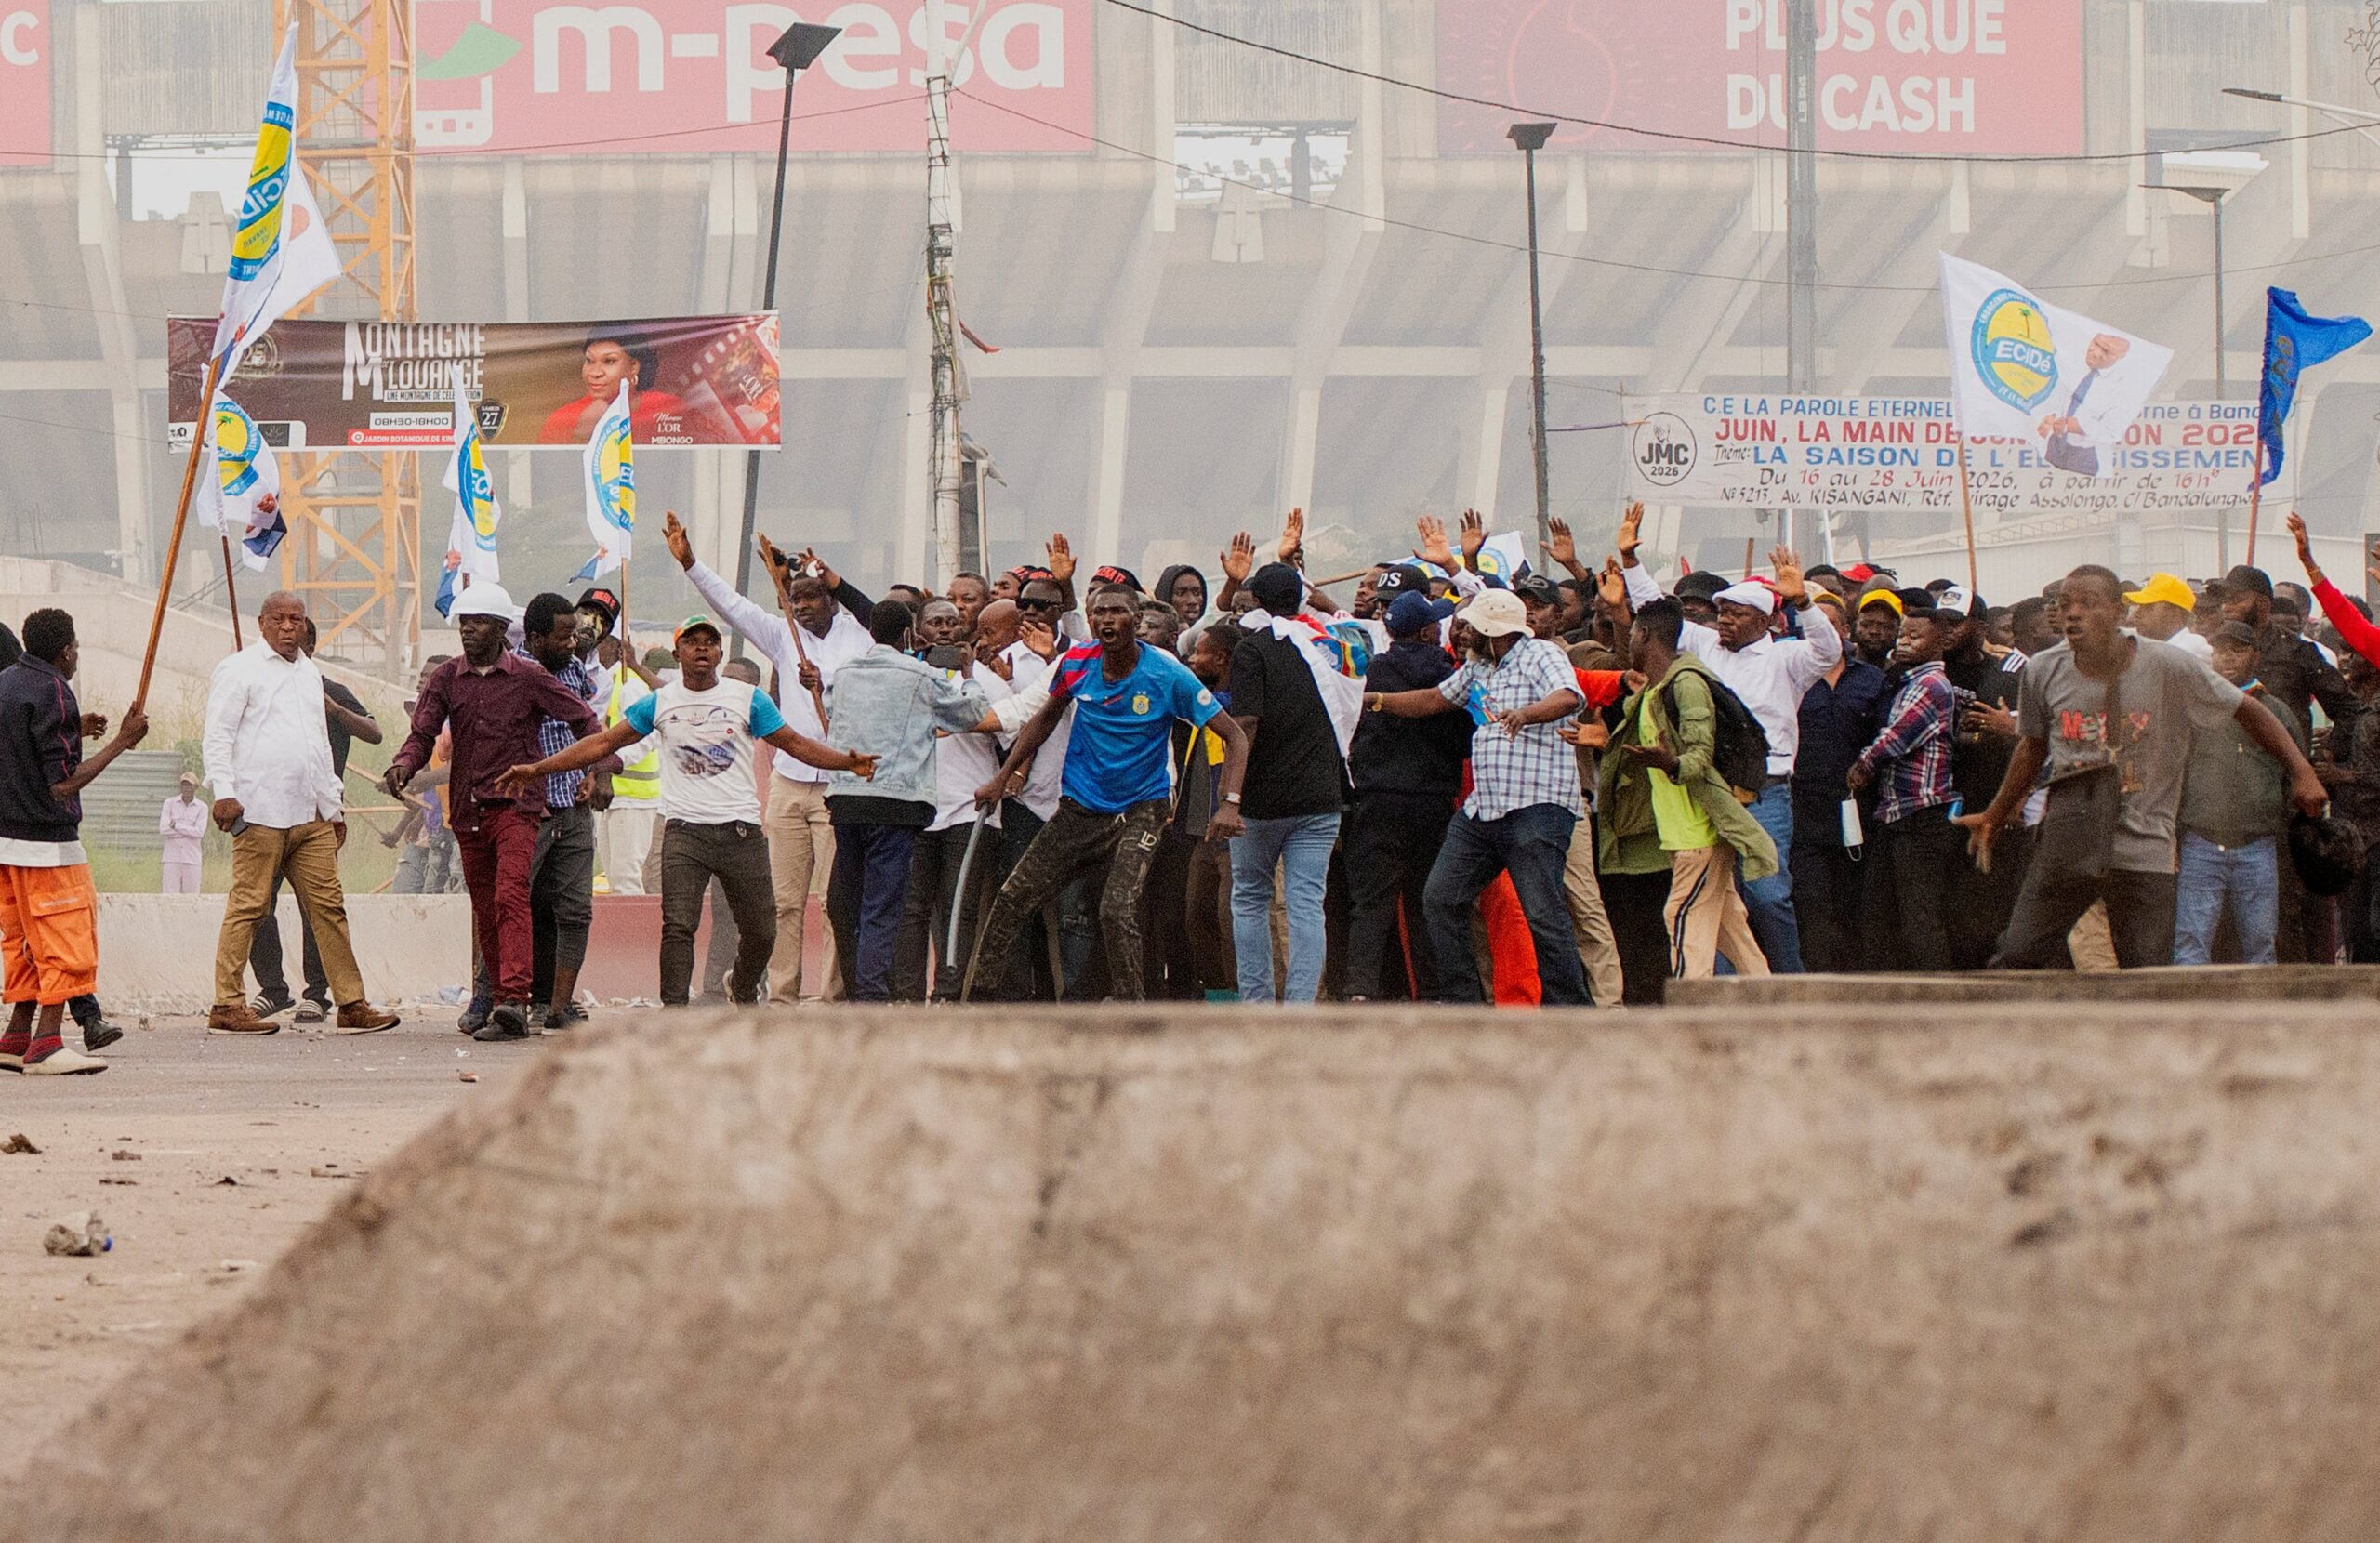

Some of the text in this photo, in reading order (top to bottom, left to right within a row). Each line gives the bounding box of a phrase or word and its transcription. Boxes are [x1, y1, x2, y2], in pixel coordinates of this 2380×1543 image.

[1726, 0, 2006, 55] PLUS QUE
[534, 4, 1064, 123] m-pesa
[1821, 74, 1975, 133] CASH
[1744, 398, 1769, 415] LA
[1781, 399, 1859, 416] PAROLE
[482, 413, 499, 426] 27
[652, 436, 694, 444] MBONGO
[1798, 420, 1831, 443] LA
[1843, 421, 1914, 443] MAIN
[1925, 422, 1961, 445] DE
[2183, 424, 2255, 446] 202
[1641, 443, 1689, 466] JMC
[1754, 446, 1788, 464] LA
[1806, 446, 1919, 467] SAISON
[1760, 468, 1786, 486] Du
[1800, 469, 1821, 485] 16
[1830, 472, 1857, 486] au
[1870, 468, 1894, 488] 28
[1905, 469, 1954, 489] Juin
[2137, 473, 2162, 490] de
[1780, 489, 1802, 505] Av.
